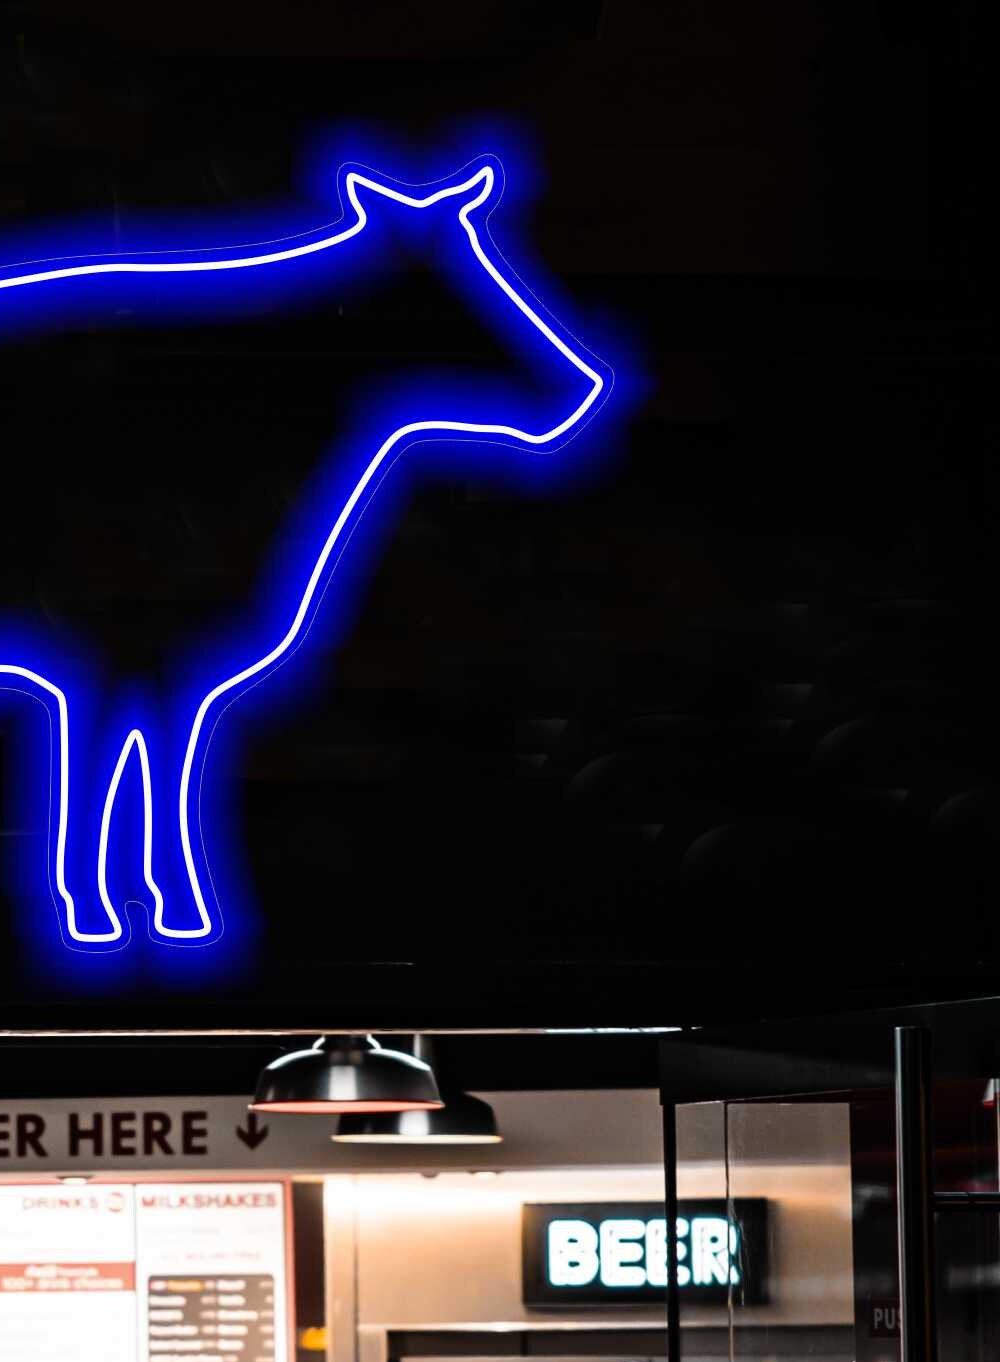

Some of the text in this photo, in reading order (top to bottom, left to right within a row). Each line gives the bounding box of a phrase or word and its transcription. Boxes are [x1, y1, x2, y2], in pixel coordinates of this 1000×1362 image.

[68, 1110, 209, 1157] HERE
[22, 1194, 99, 1211] DRINKS
[142, 1192, 278, 1210] MILKSHAKES
[548, 1217, 741, 1288] BEER
